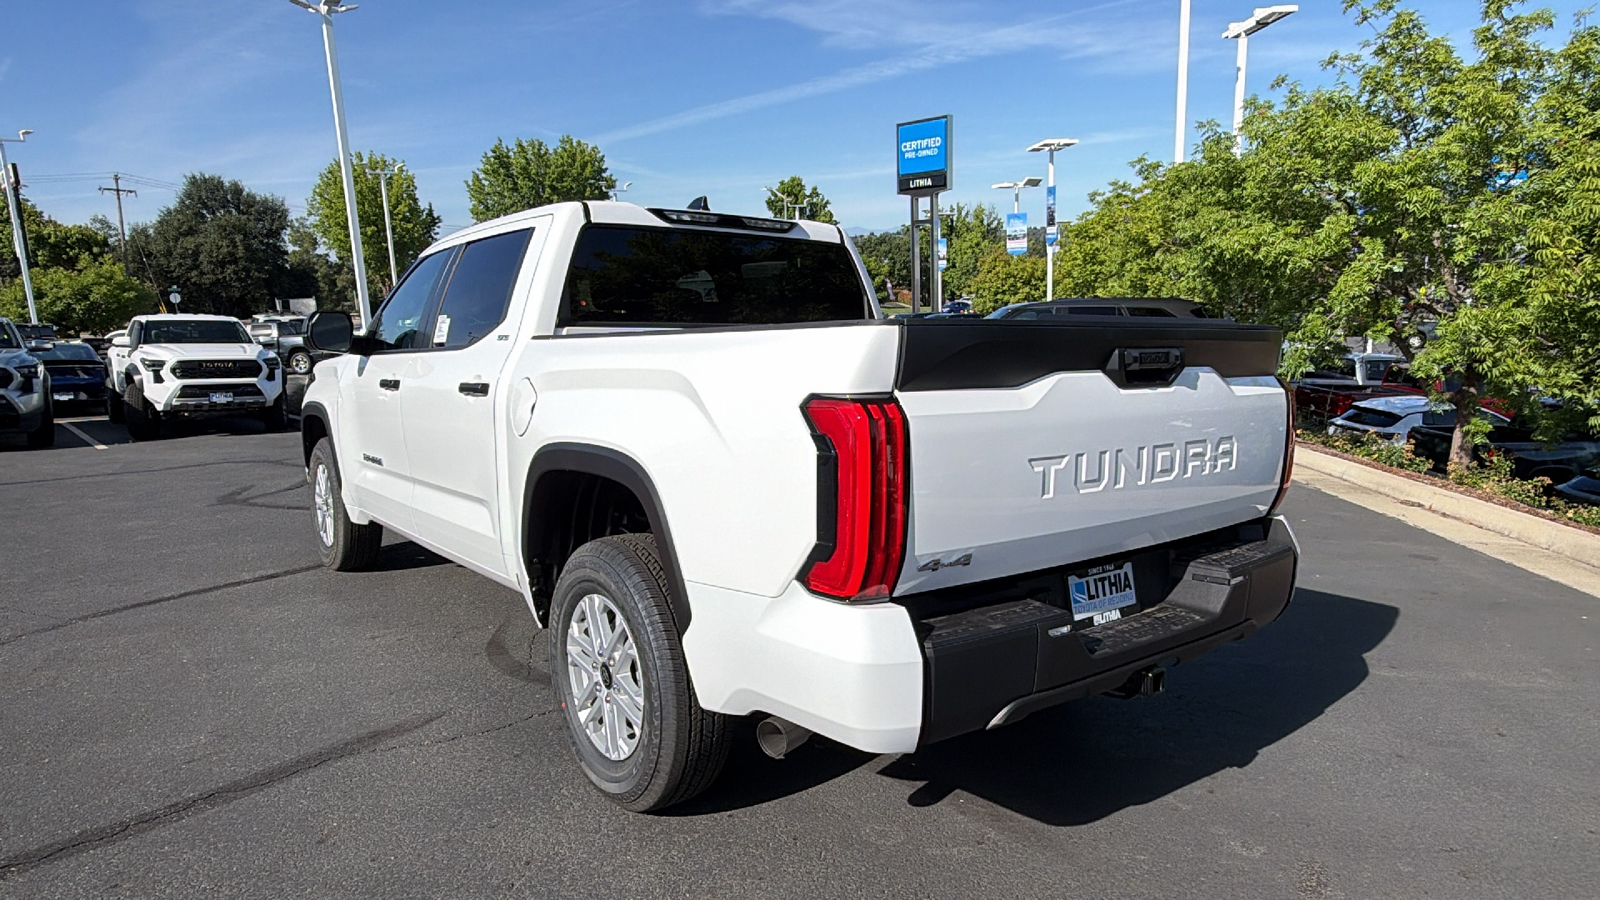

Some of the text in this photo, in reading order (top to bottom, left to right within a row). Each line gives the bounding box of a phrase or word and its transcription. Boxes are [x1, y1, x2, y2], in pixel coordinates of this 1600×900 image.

[901, 136, 942, 152] CERTIFIED
[904, 147, 939, 160] PRE-OWNED
[910, 177, 932, 188] LITHIA
[201, 361, 234, 369] TOYOTA
[1028, 435, 1237, 499] TUNDRA
[1088, 565, 1103, 576] SINCE
[1085, 571, 1133, 600] LITHIA
[1073, 592, 1134, 614] TOYOTA OF REDDING
[1099, 609, 1121, 623] LITHIA
